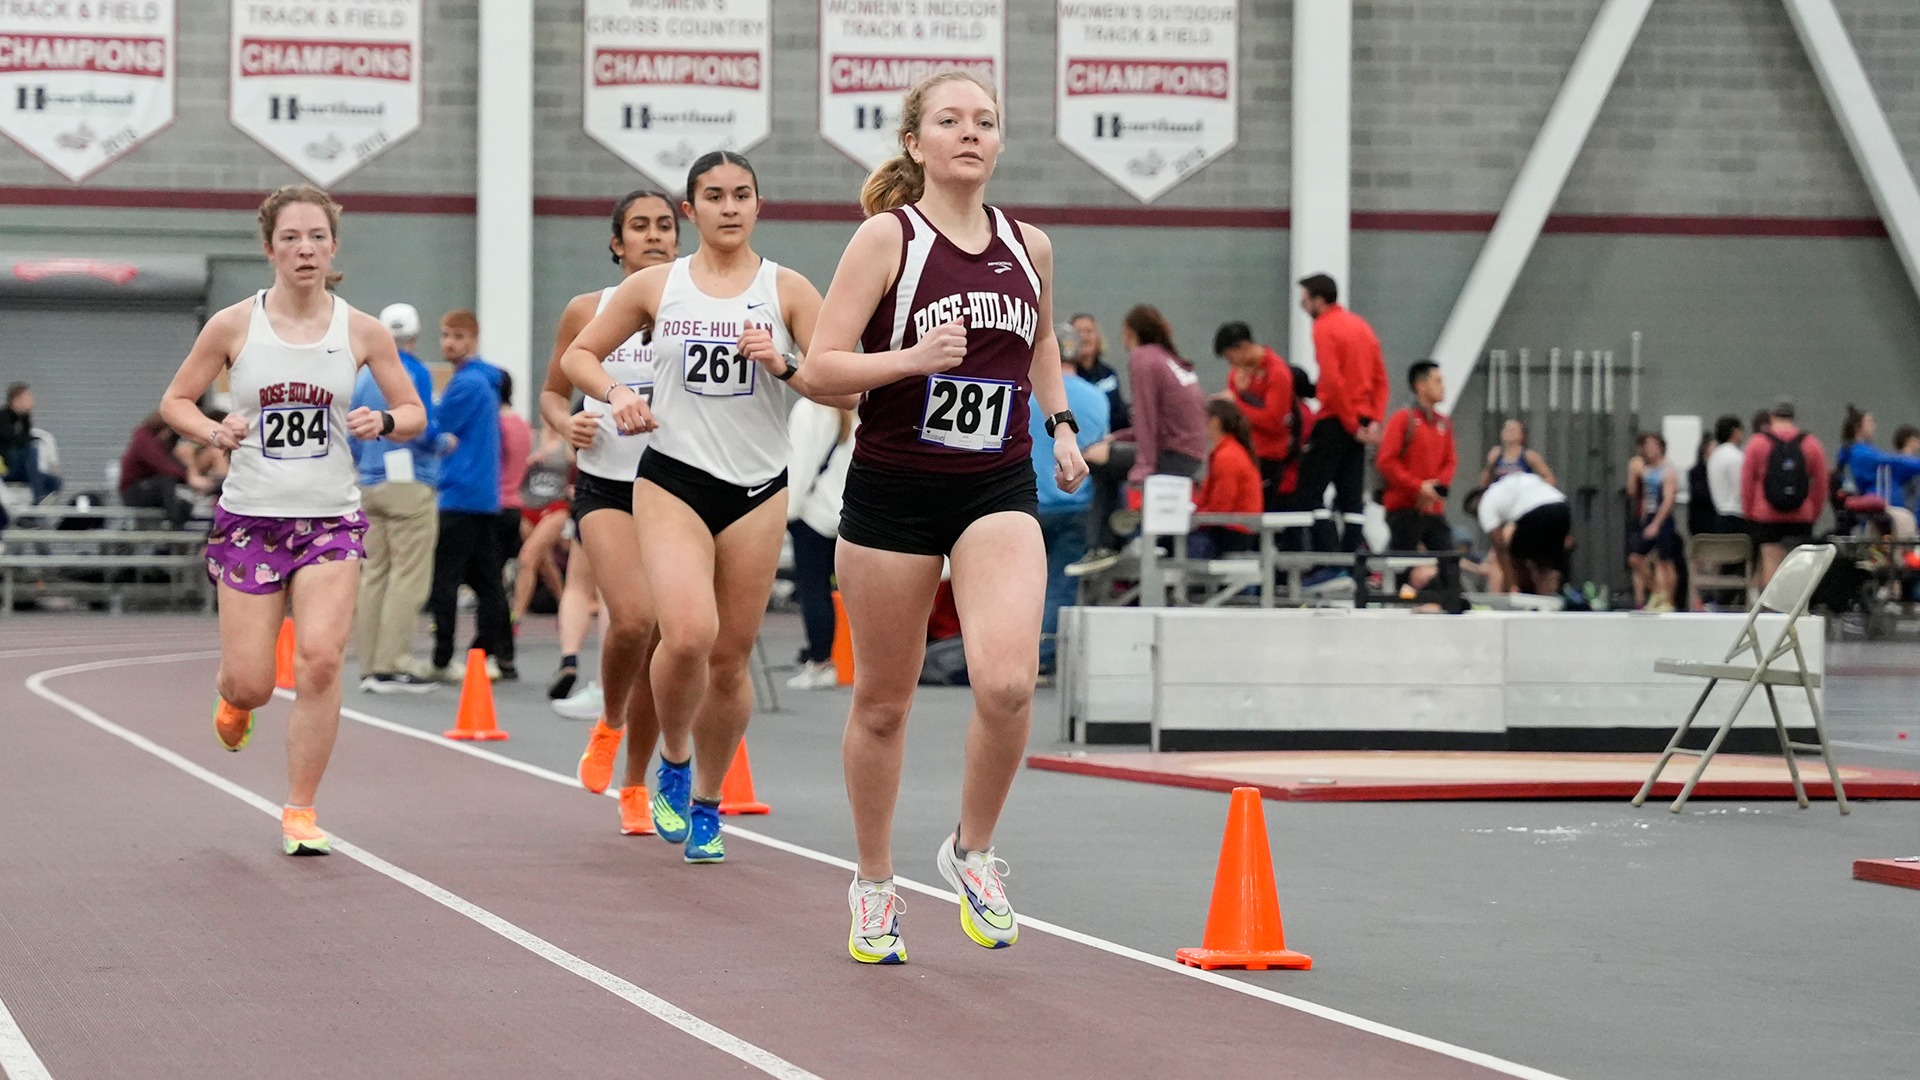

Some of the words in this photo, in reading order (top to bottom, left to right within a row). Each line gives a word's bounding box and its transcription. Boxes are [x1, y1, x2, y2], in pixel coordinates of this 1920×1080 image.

[345, 8, 407, 30] FIELD
[0, 36, 164, 72] CHAMPIONS
[241, 43, 410, 78] CHAMPIONS
[595, 52, 760, 87] CHAMPIONS
[1067, 63, 1227, 96] CHAMPIONS
[686, 344, 748, 384] 261
[259, 382, 334, 407] ROSE-HULMAN
[925, 380, 1006, 436] 281
[265, 409, 327, 448] 284
